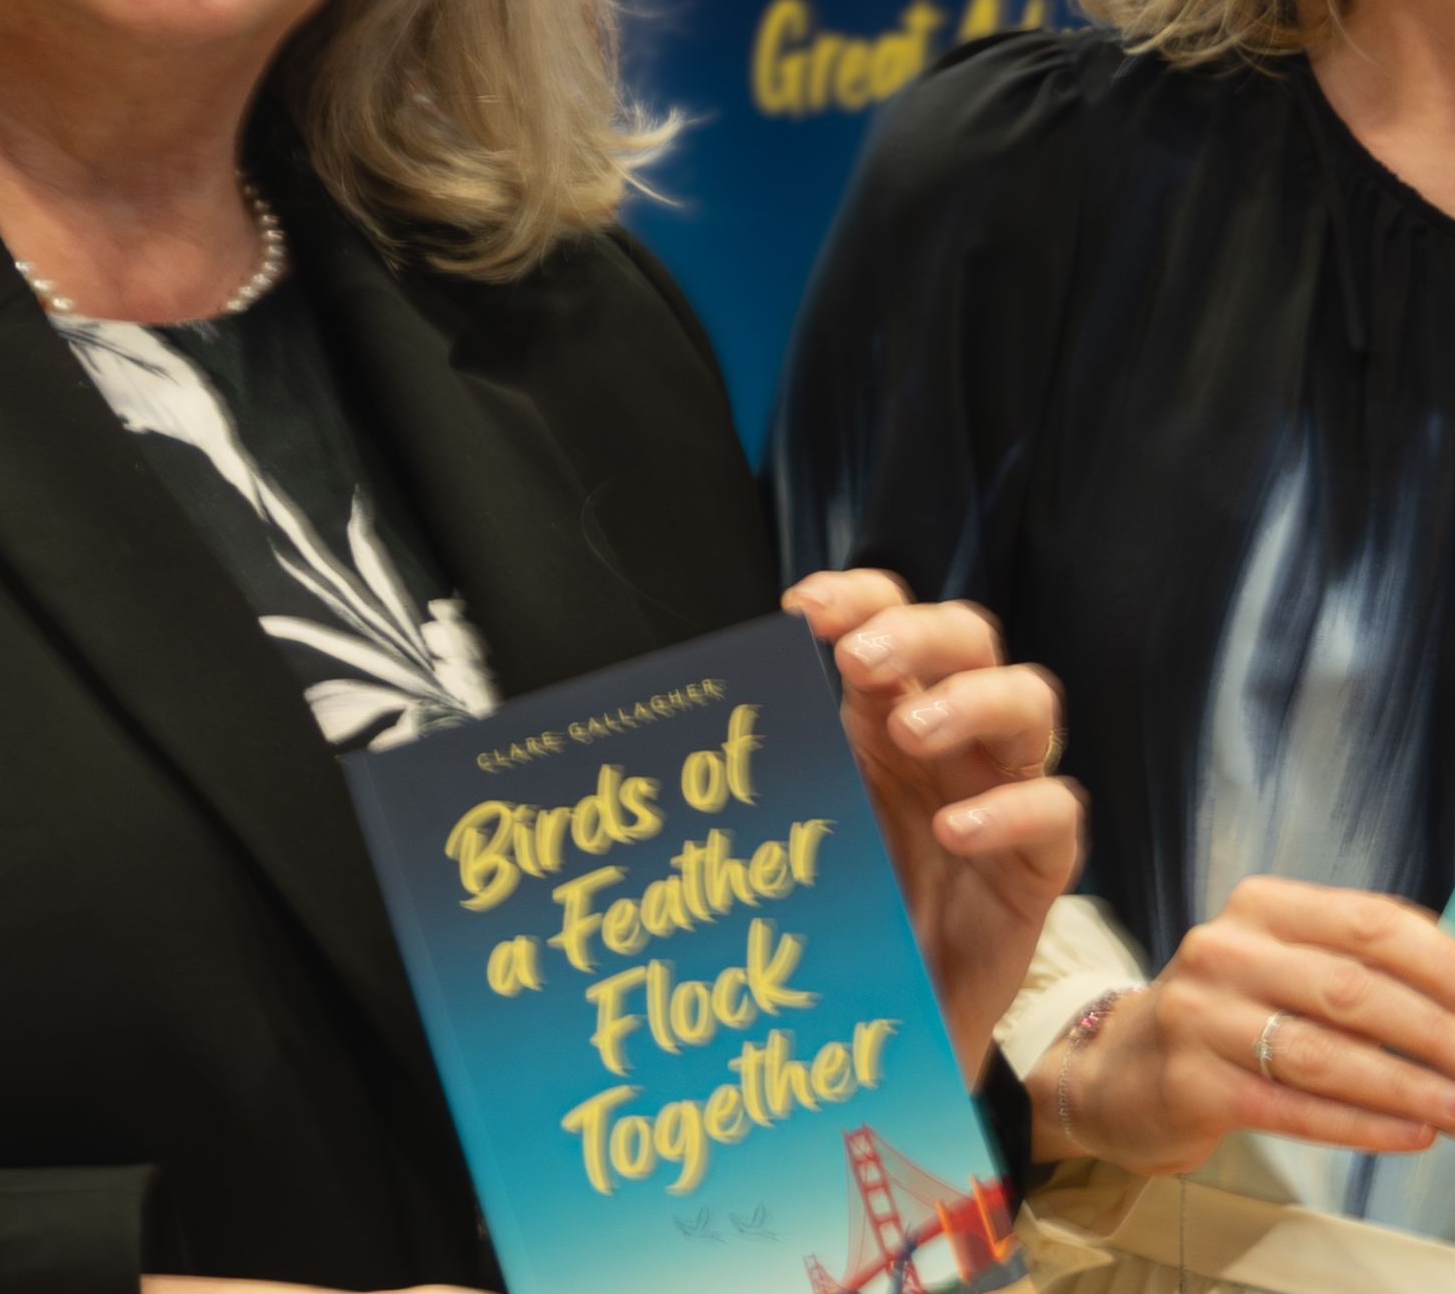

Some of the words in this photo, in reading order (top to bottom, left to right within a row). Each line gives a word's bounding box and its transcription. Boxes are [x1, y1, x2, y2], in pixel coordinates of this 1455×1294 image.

[445, 764, 661, 911] Birds
[681, 704, 765, 813] of
[476, 731, 567, 774] CLARE
[567, 678, 728, 745] GALLAGHER
[486, 934, 544, 998] a
[548, 818, 837, 973] Feather
[585, 918, 821, 1076] Flock
[561, 1018, 902, 1196] Together
